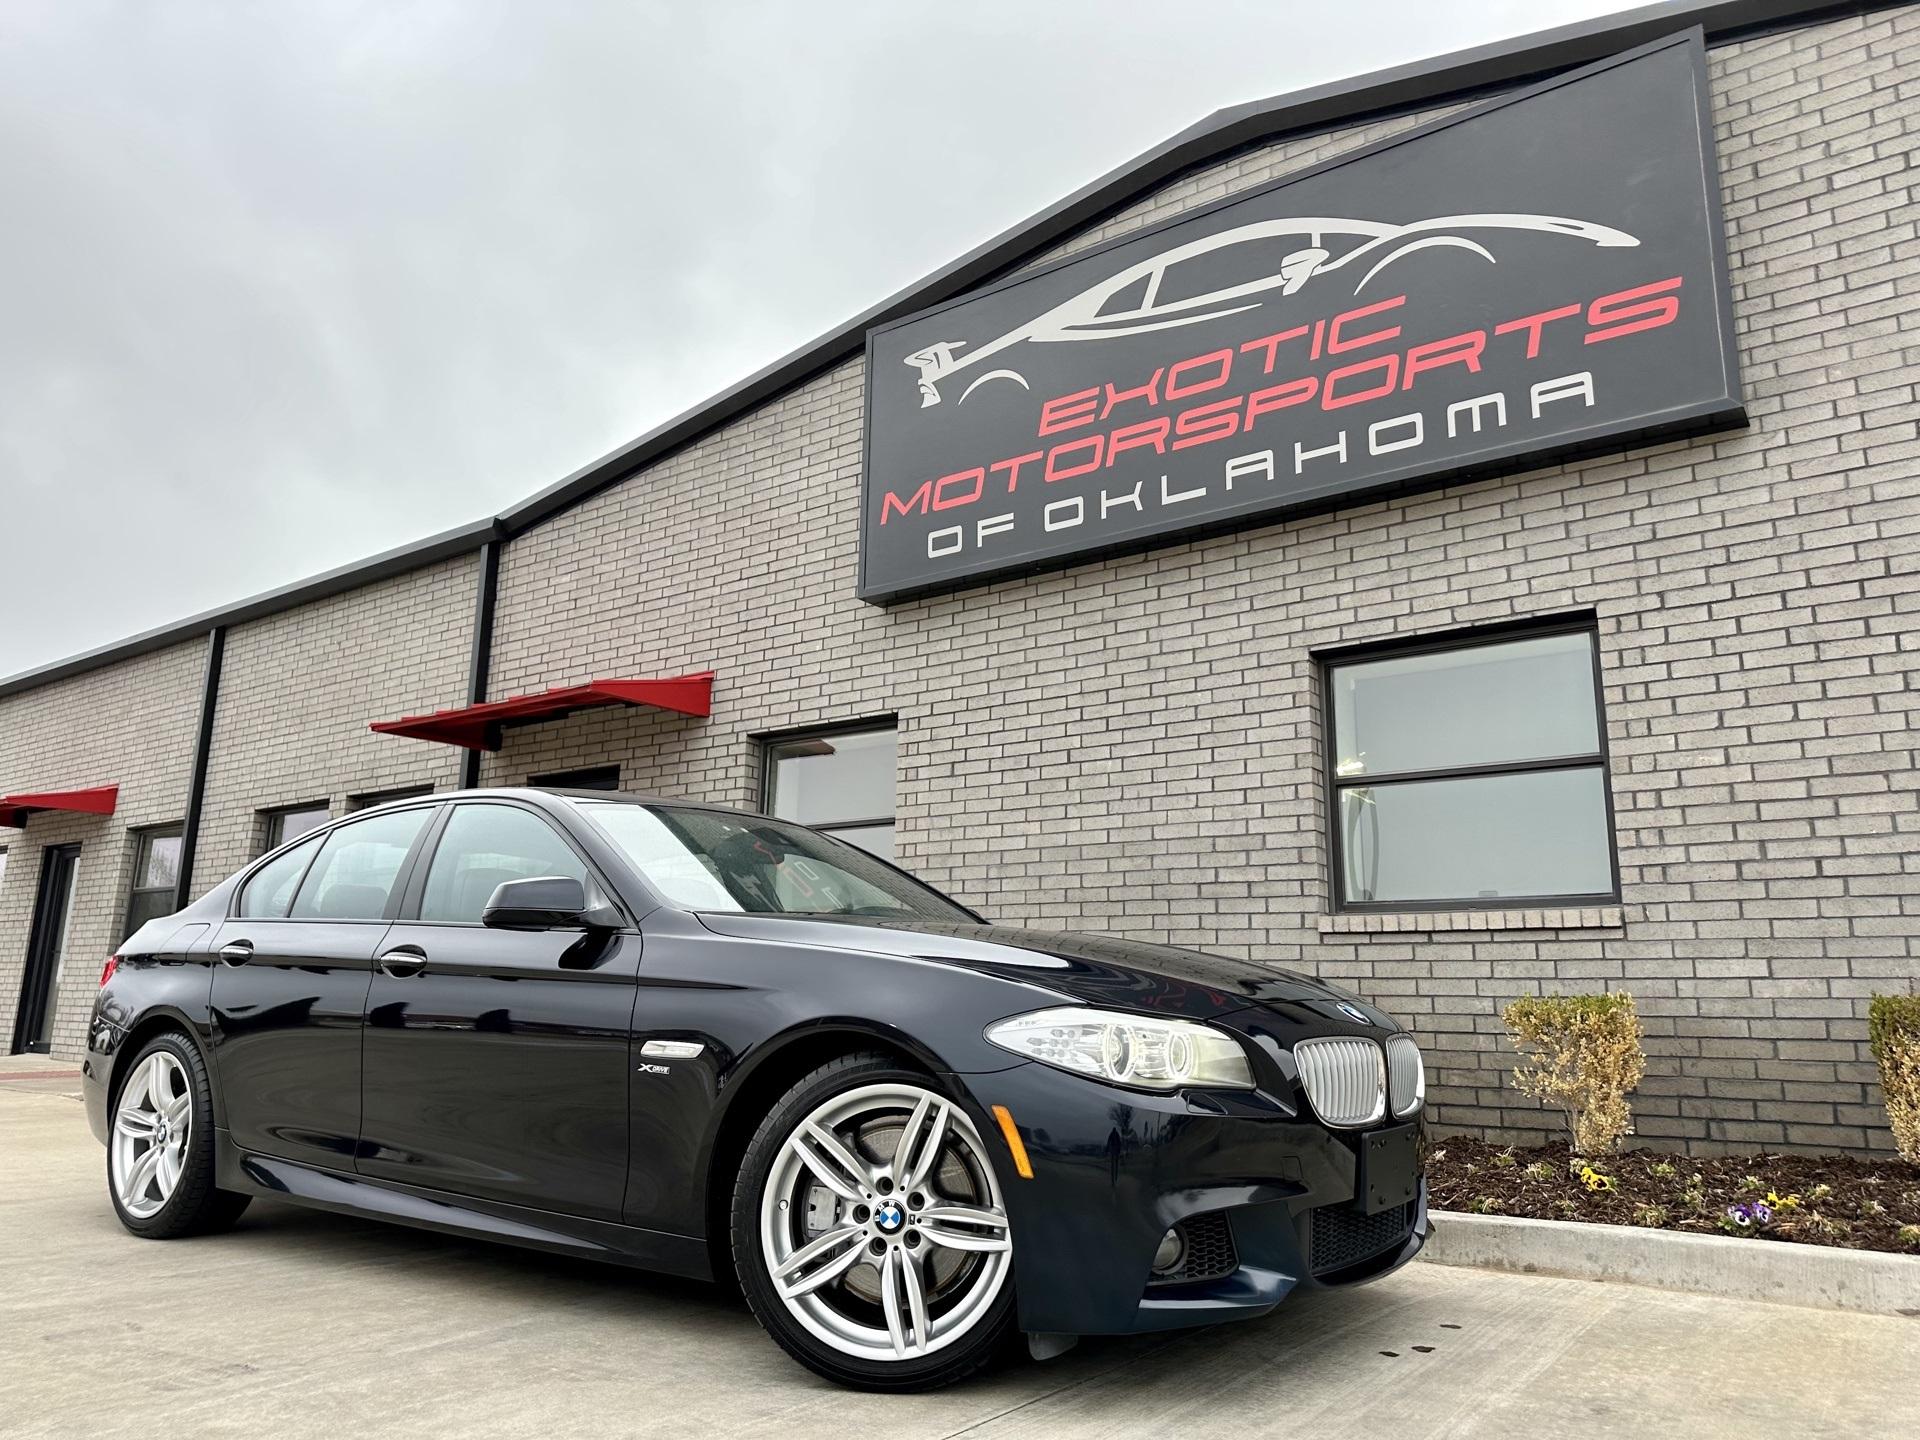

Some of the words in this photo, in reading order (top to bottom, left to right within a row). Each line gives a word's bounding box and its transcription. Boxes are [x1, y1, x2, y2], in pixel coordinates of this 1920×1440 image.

[880, 276, 1683, 525] MOTORSPORTS
[1038, 295, 1406, 437] EXOTIC
[927, 512, 1015, 559] OF
[1044, 371, 1595, 533] OKLAHOMA
